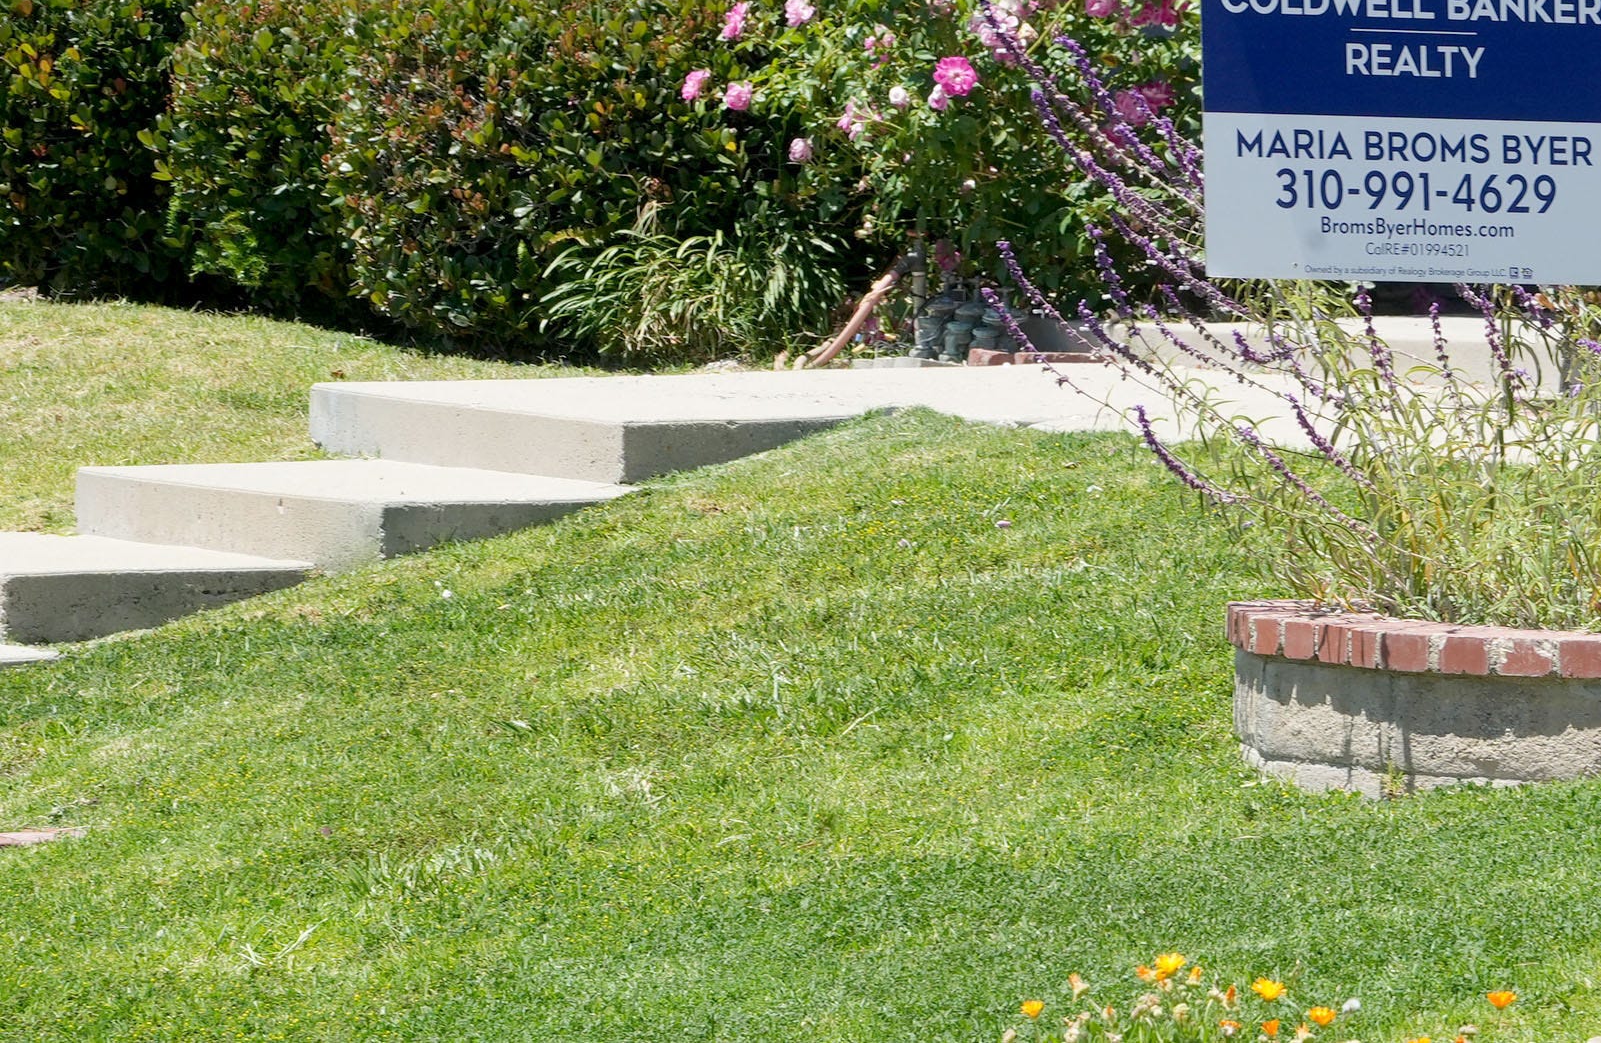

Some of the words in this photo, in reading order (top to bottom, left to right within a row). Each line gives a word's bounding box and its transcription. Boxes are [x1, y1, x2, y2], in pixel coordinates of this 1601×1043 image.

[1346, 43, 1485, 79] REALTY
[1236, 129, 1353, 161] MARIA
[1365, 132, 1489, 165] BROMS
[1502, 136, 1593, 167] BYER
[1275, 169, 1557, 215] 310-991-4629
[1321, 216, 1514, 239] BromsByerHomes.com
[1365, 242, 1470, 257] CalRE#01994521
